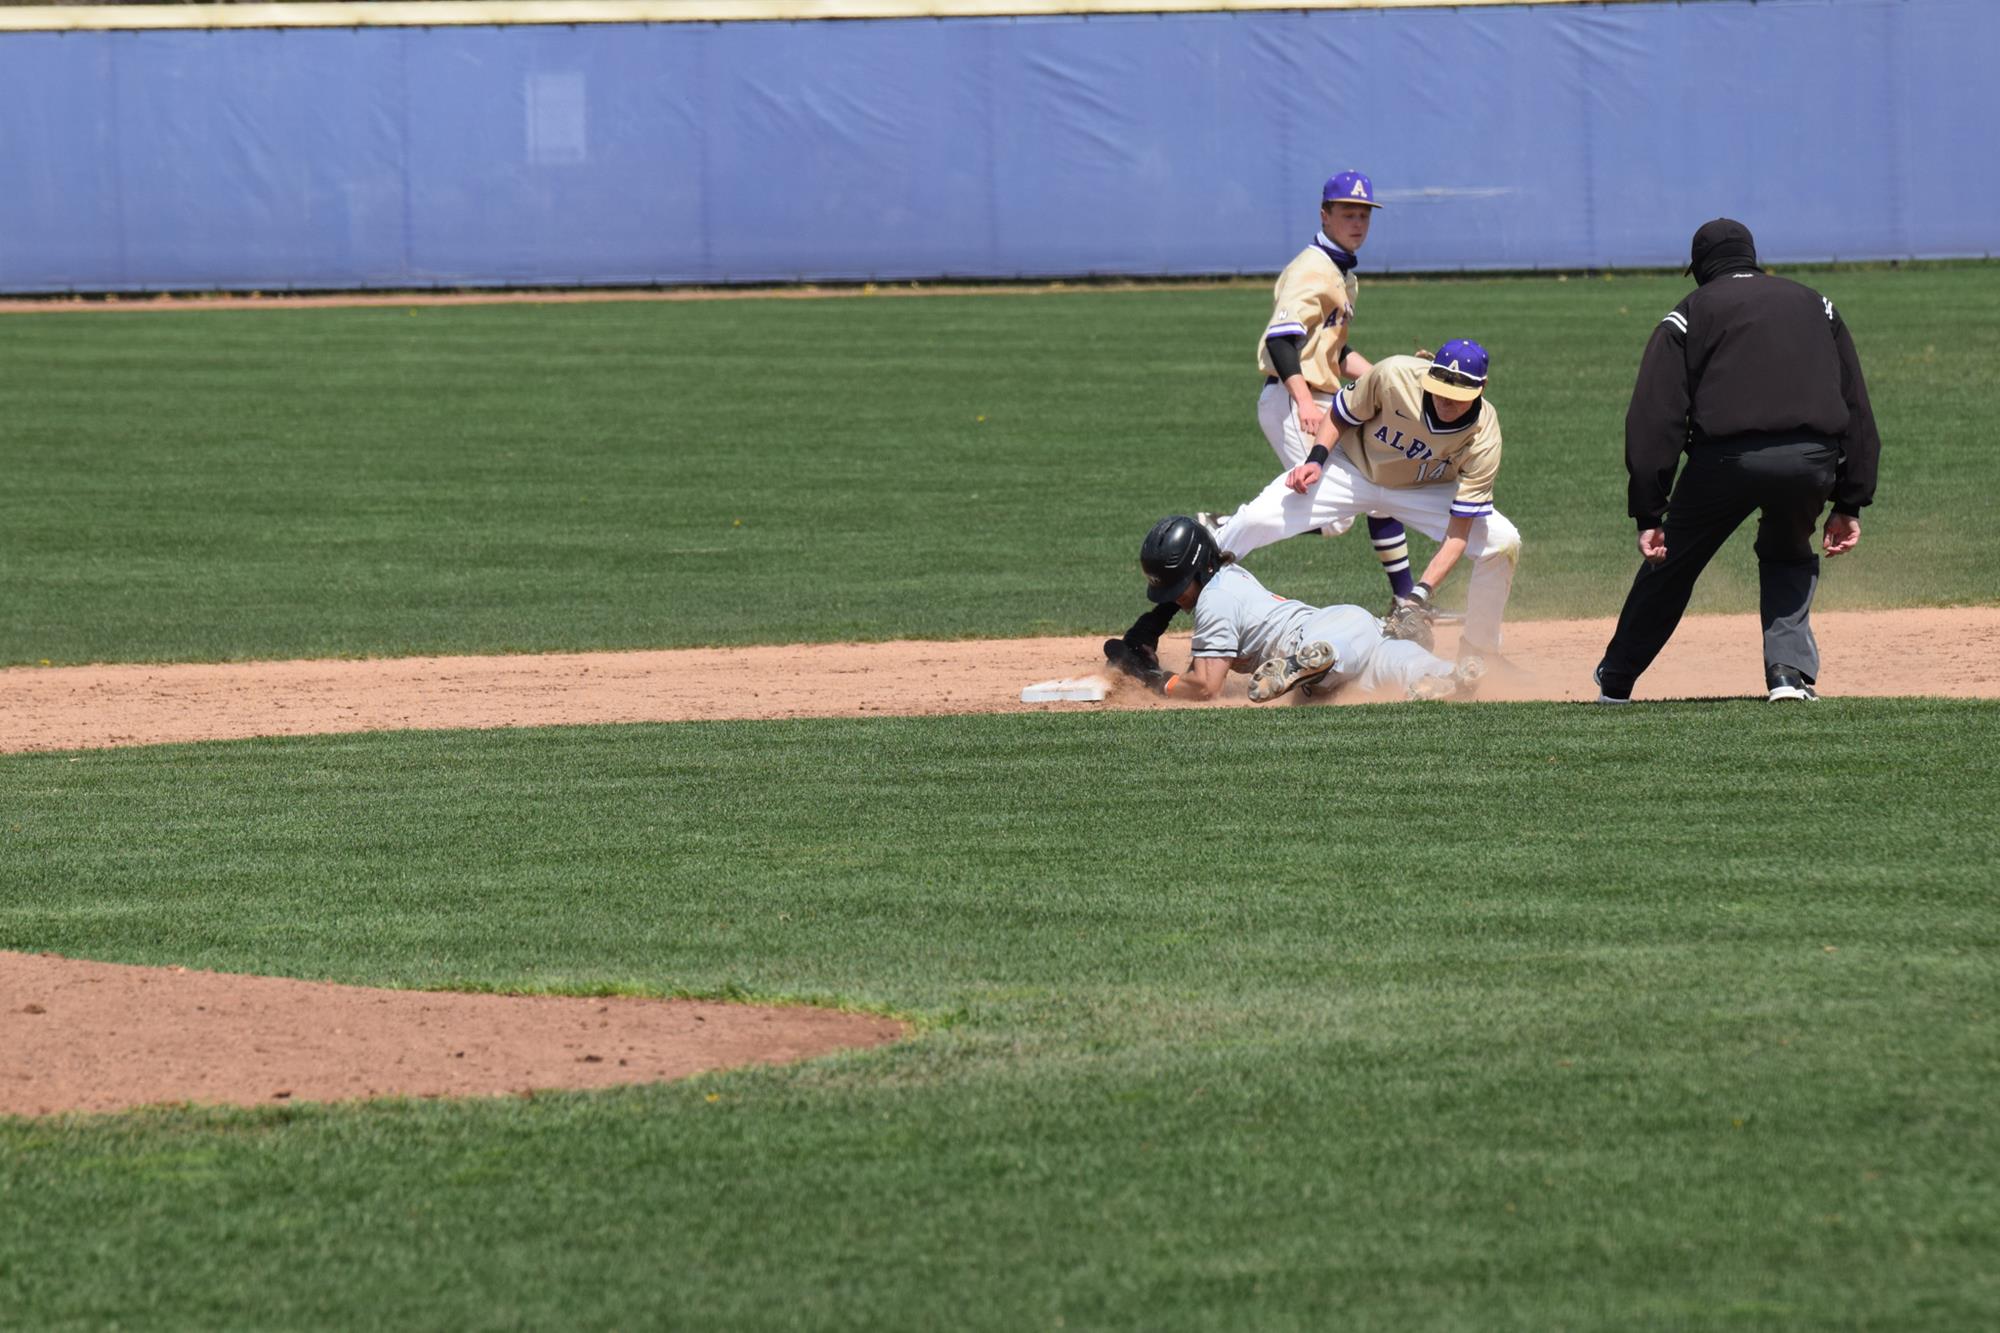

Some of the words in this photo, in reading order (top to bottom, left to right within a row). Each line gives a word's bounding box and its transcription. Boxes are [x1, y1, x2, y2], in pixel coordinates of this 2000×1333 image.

[1351, 179, 1368, 198] A
[1448, 359, 1460, 372] A
[1417, 462, 1448, 481] 14
